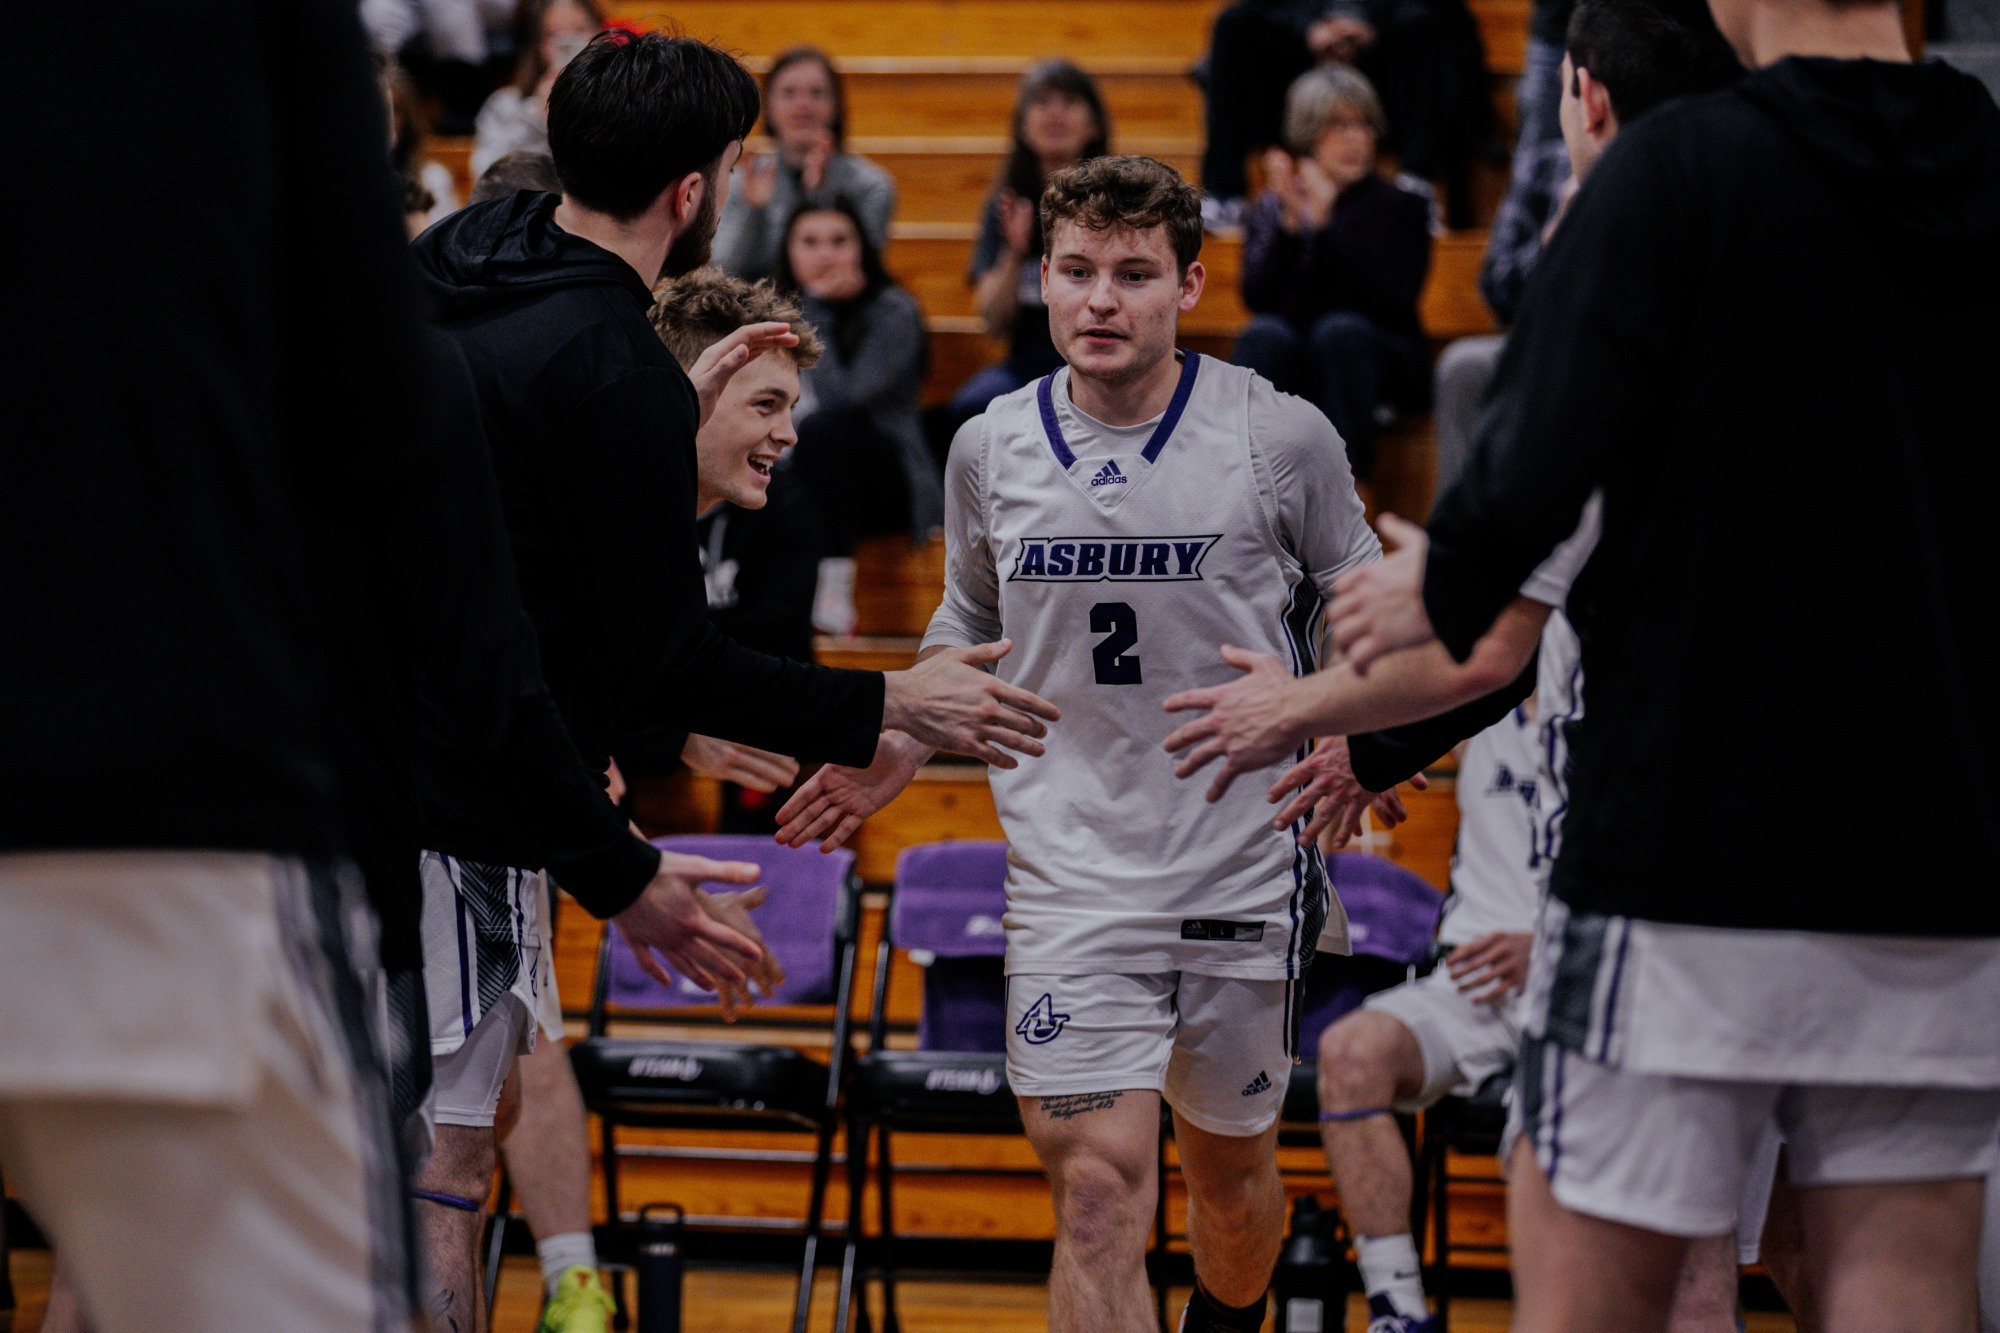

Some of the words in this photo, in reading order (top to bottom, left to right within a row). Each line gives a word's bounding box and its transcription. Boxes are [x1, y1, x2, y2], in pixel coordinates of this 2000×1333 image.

[1091, 474, 1127, 487] adidas
[1019, 541, 1207, 576] ASBURY
[1089, 602, 1142, 685] 2
